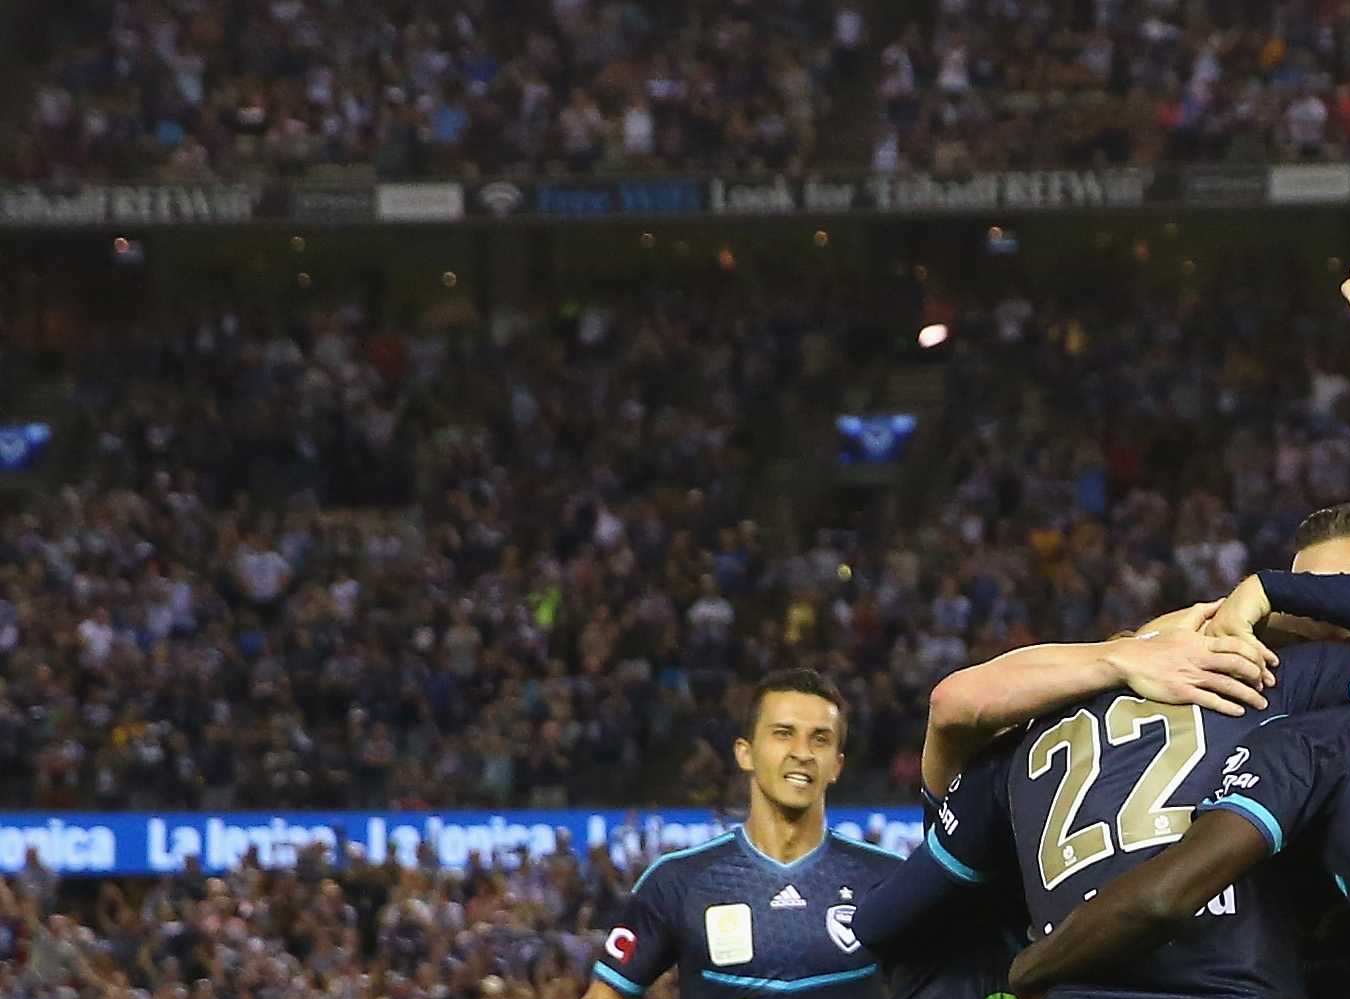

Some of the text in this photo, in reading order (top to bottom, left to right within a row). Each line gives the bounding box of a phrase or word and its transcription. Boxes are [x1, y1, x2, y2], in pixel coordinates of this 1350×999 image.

[1028, 695, 1206, 890] 22
[148, 817, 200, 871] La
[605, 927, 636, 959] C
